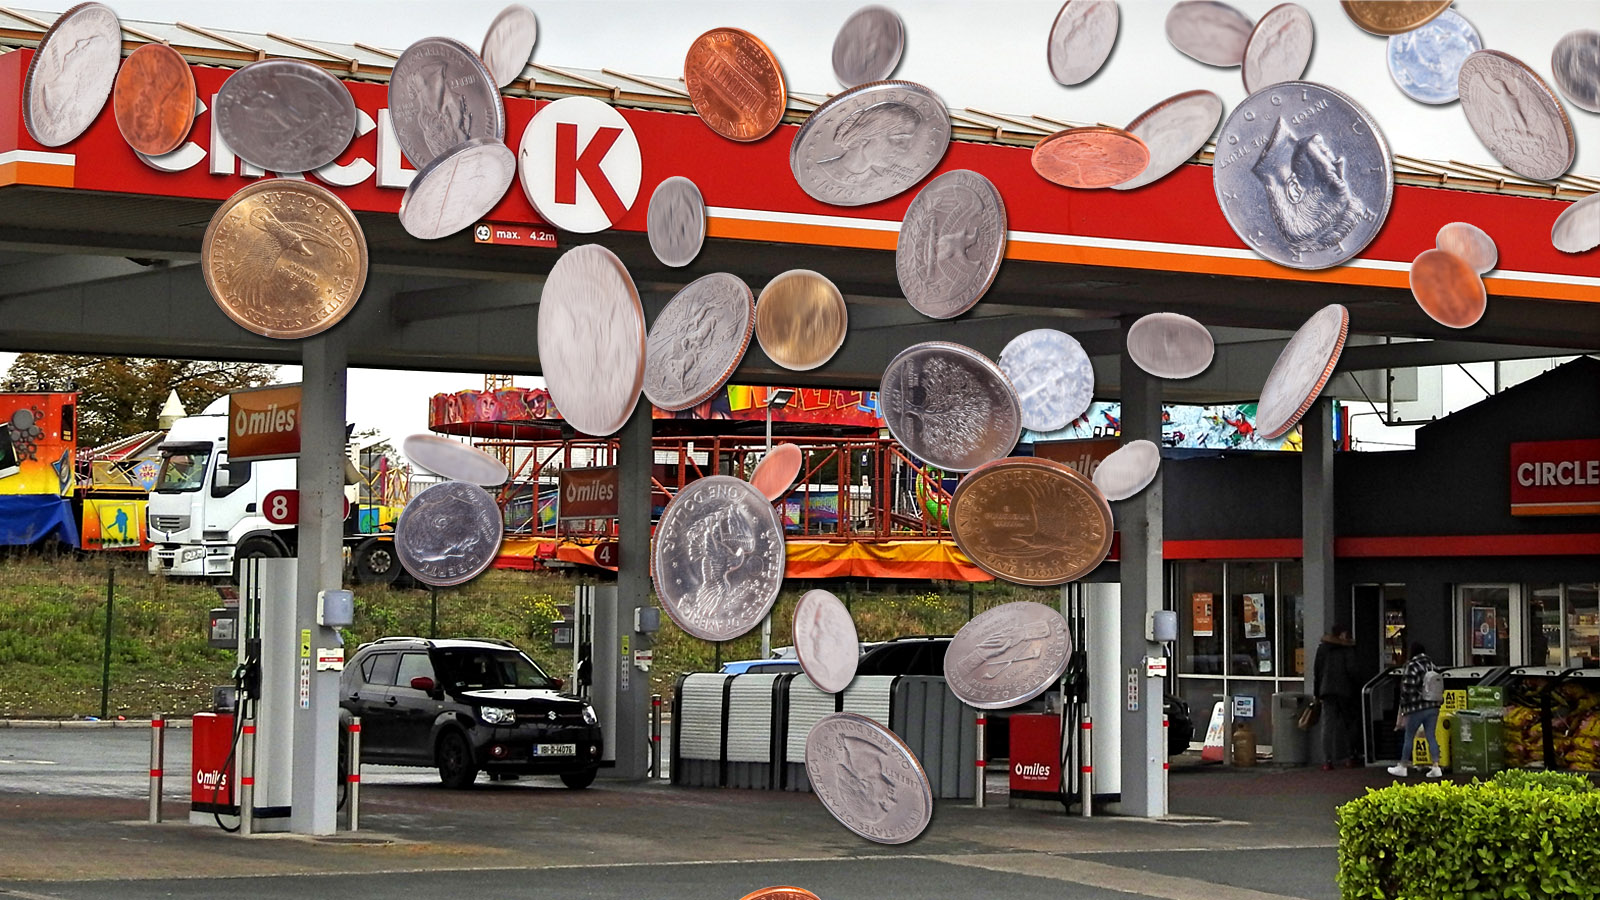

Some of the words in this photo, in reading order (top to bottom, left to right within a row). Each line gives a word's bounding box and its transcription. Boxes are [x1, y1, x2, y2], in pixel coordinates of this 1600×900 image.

[554, 122, 628, 226] K
[496, 230, 520, 240] max.
[530, 231, 554, 241] 4.2m
[248, 403, 296, 435] miles
[1517, 461, 1600, 487] CIRCLE
[577, 480, 614, 502] miles
[272, 496, 288, 520] 8
[600, 546, 610, 562] 4
[1446, 692, 1456, 700] A1
[1416, 740, 1426, 751] A1
[1023, 762, 1050, 776] miles
